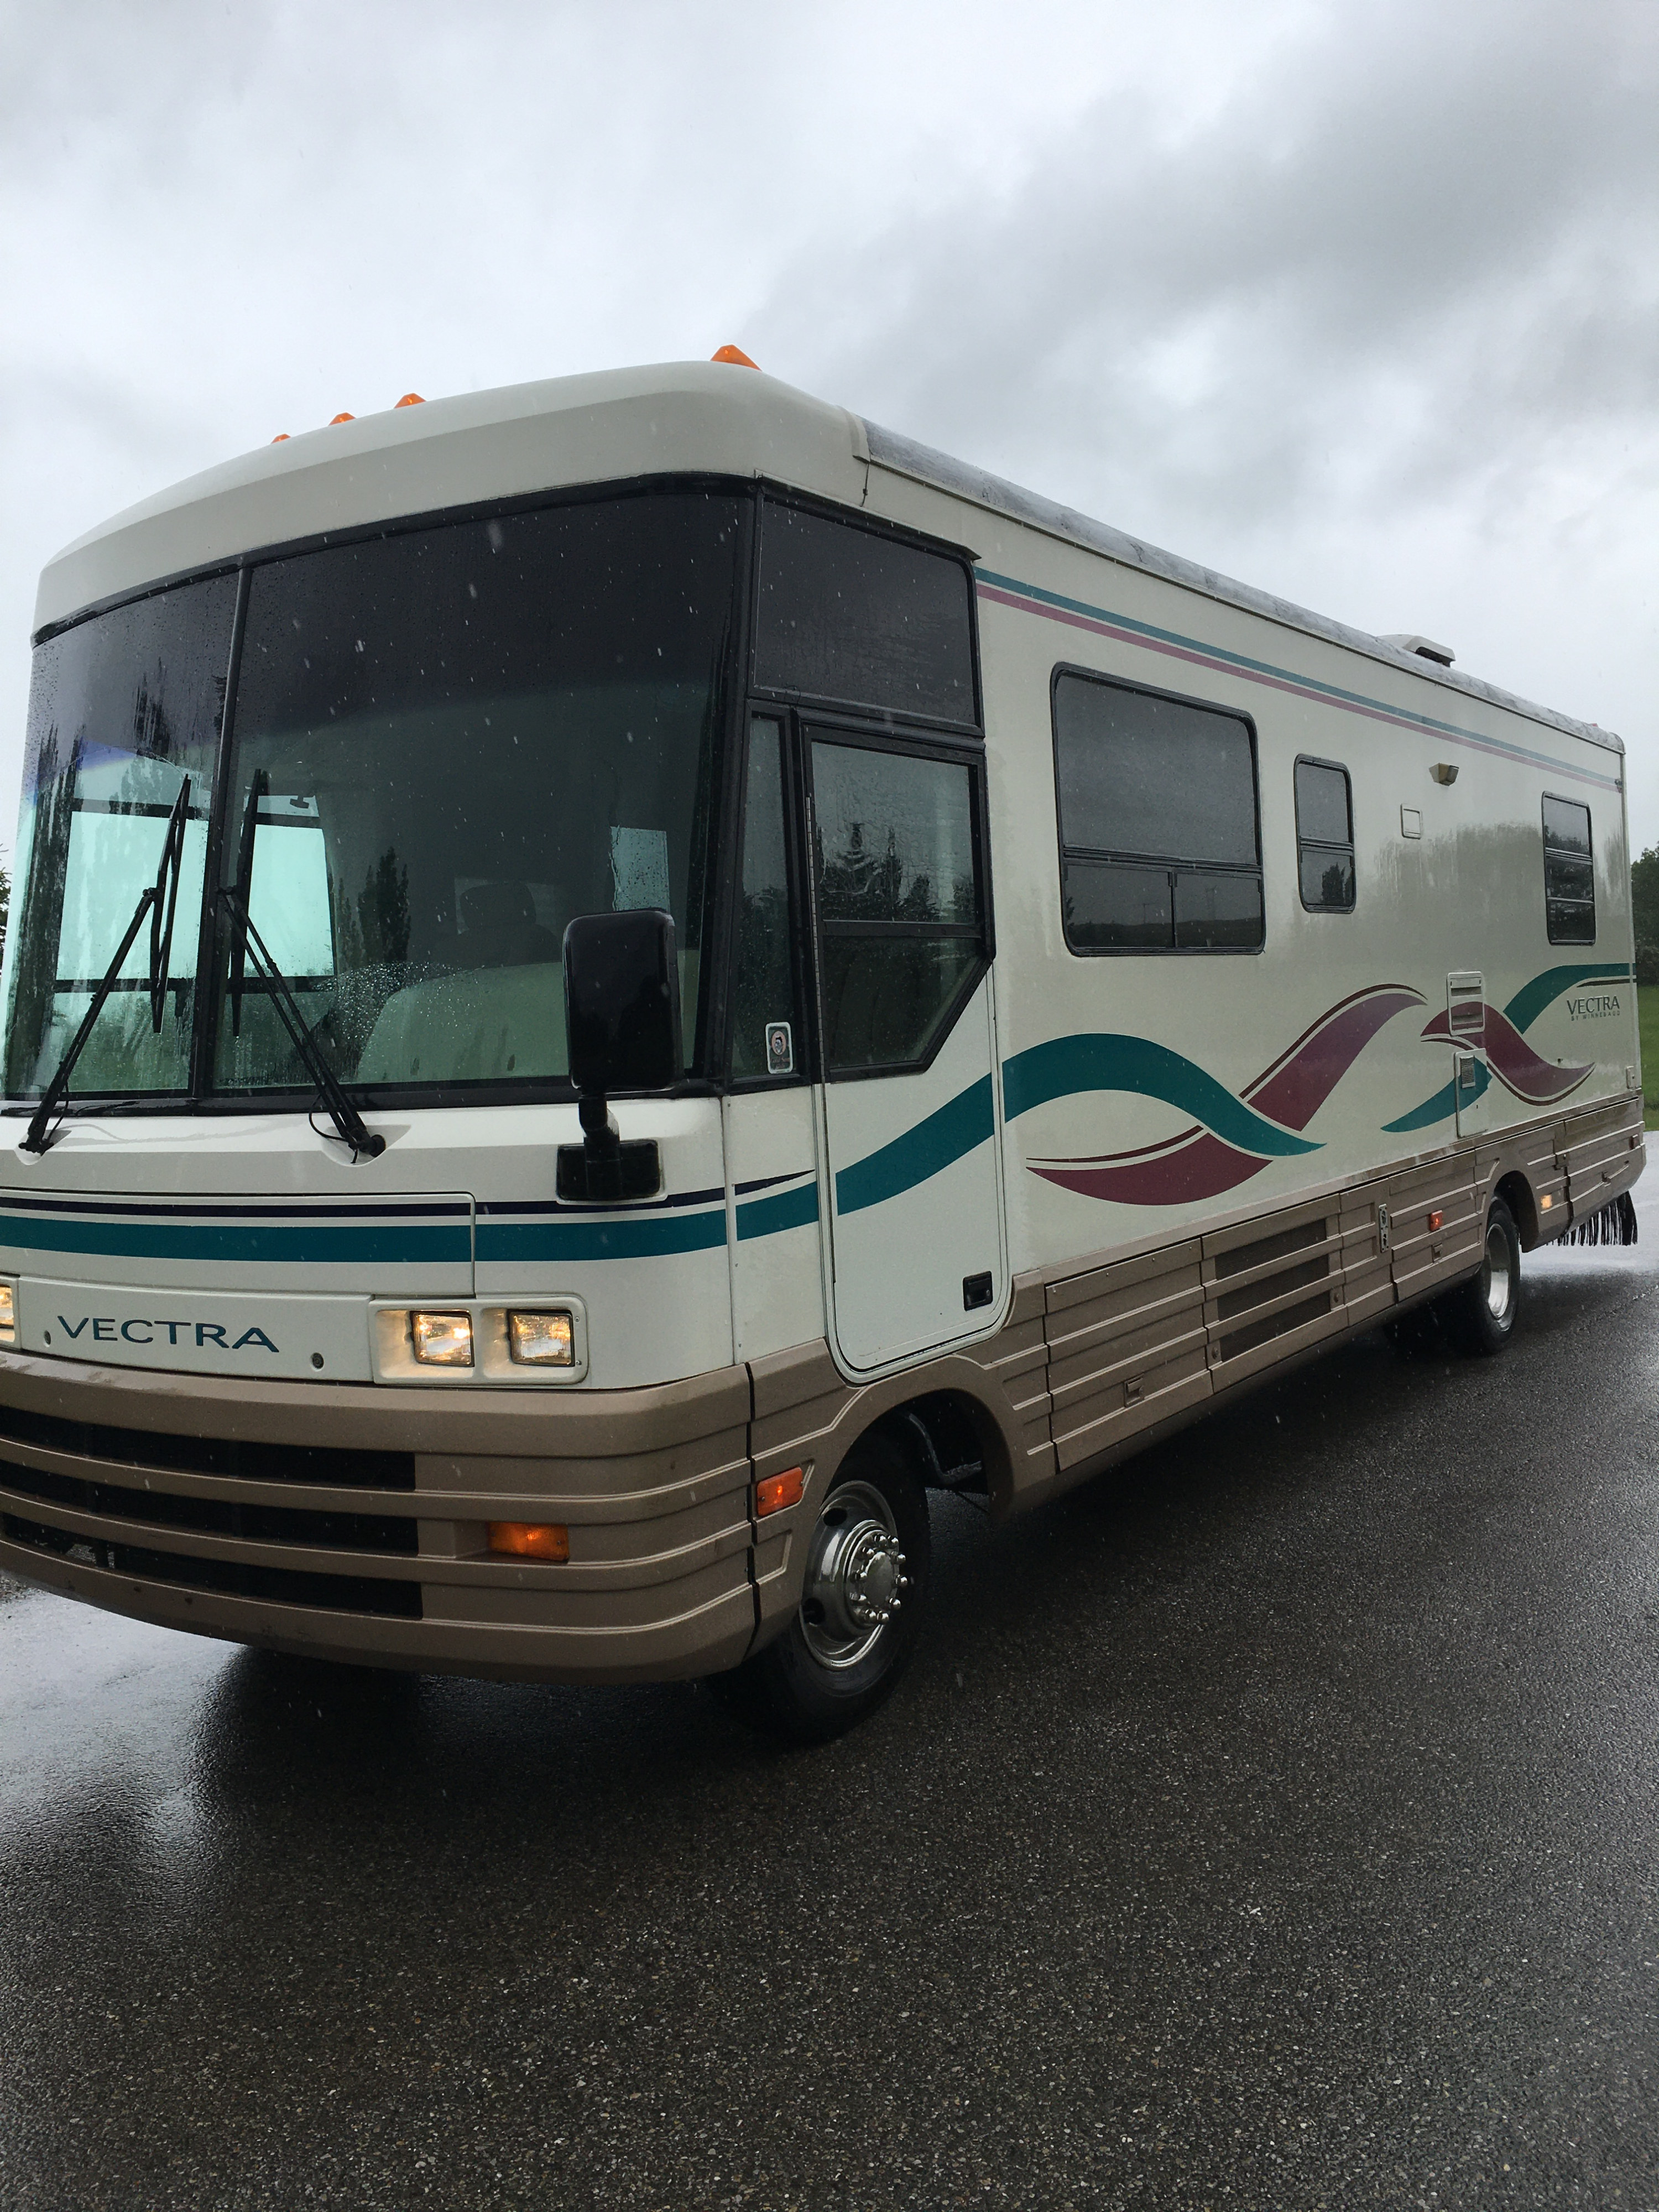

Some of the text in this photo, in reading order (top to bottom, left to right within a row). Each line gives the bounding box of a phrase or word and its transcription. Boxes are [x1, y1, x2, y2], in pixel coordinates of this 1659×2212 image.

[1567, 996, 1620, 1015] VECTRA
[1583, 1010, 1620, 1019] WINNEBAGO
[58, 1316, 279, 1353] VECTRA
